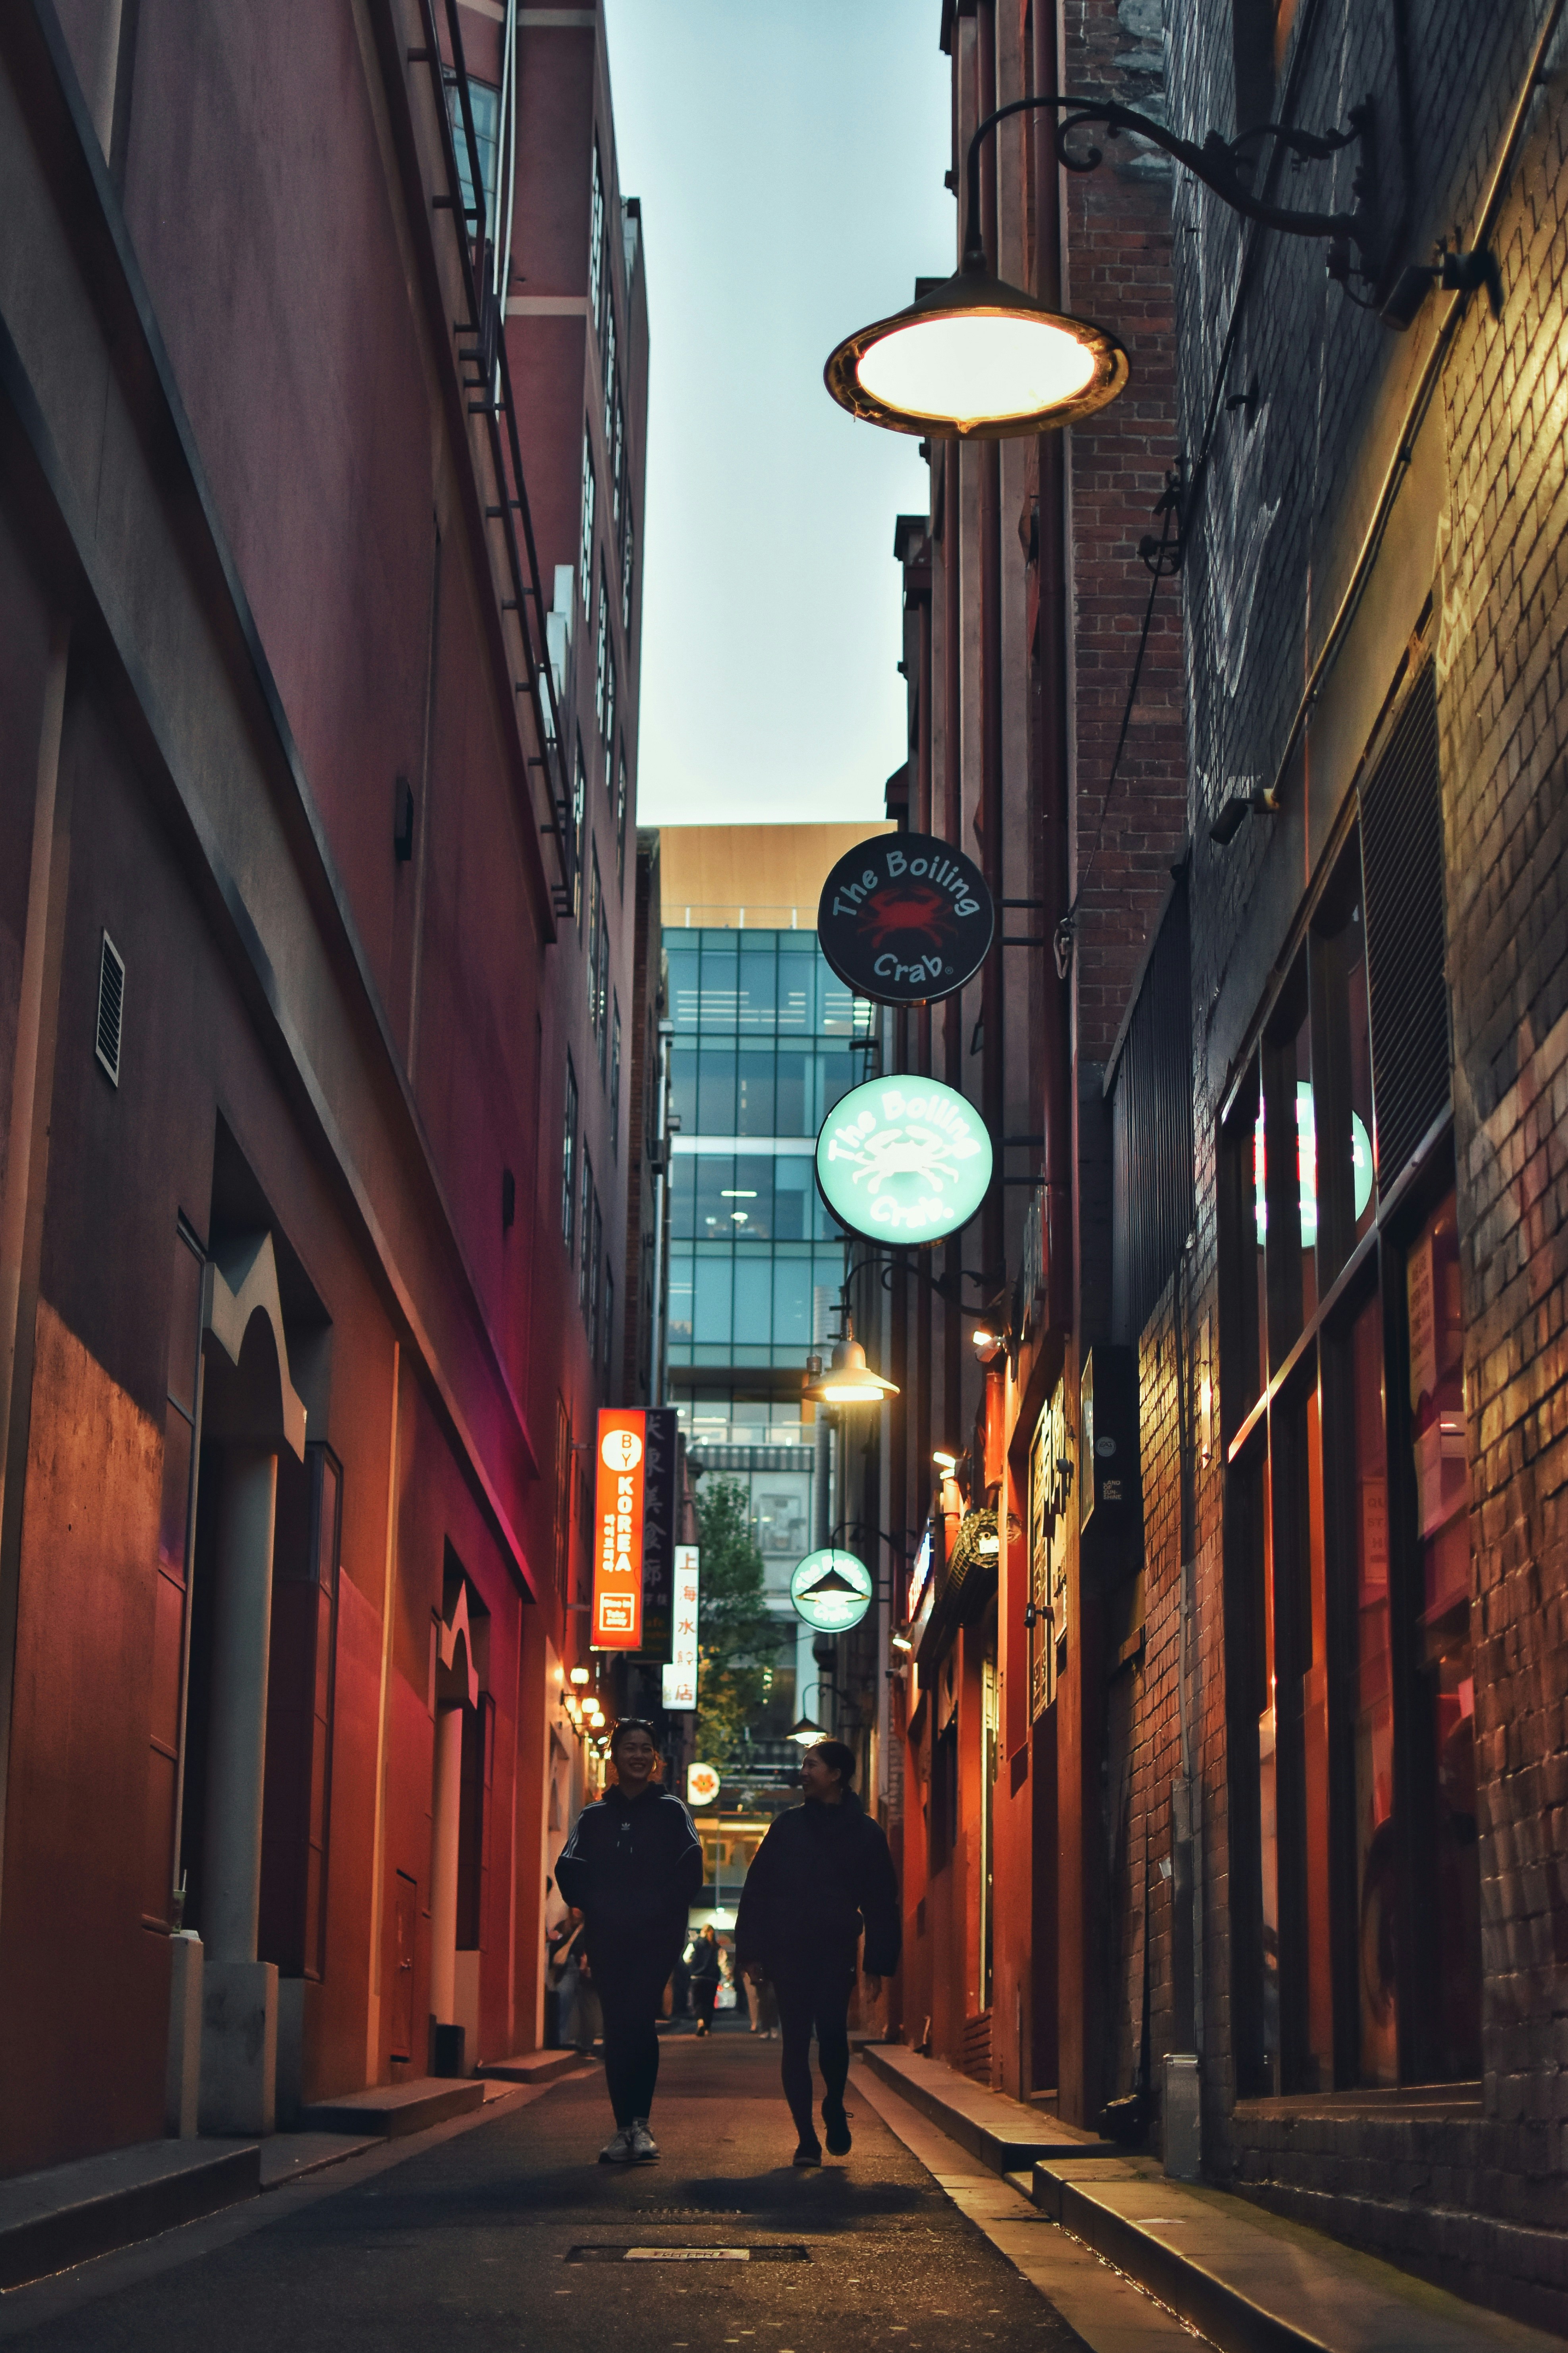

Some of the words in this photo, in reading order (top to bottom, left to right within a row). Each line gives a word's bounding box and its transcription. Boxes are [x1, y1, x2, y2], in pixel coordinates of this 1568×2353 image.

[833, 869, 878, 916] The
[886, 851, 980, 916] Boiling
[874, 953, 942, 982] Crab
[828, 1111, 876, 1160] The
[622, 1435, 631, 1467] BY
[614, 1477, 633, 1571] KOREA
